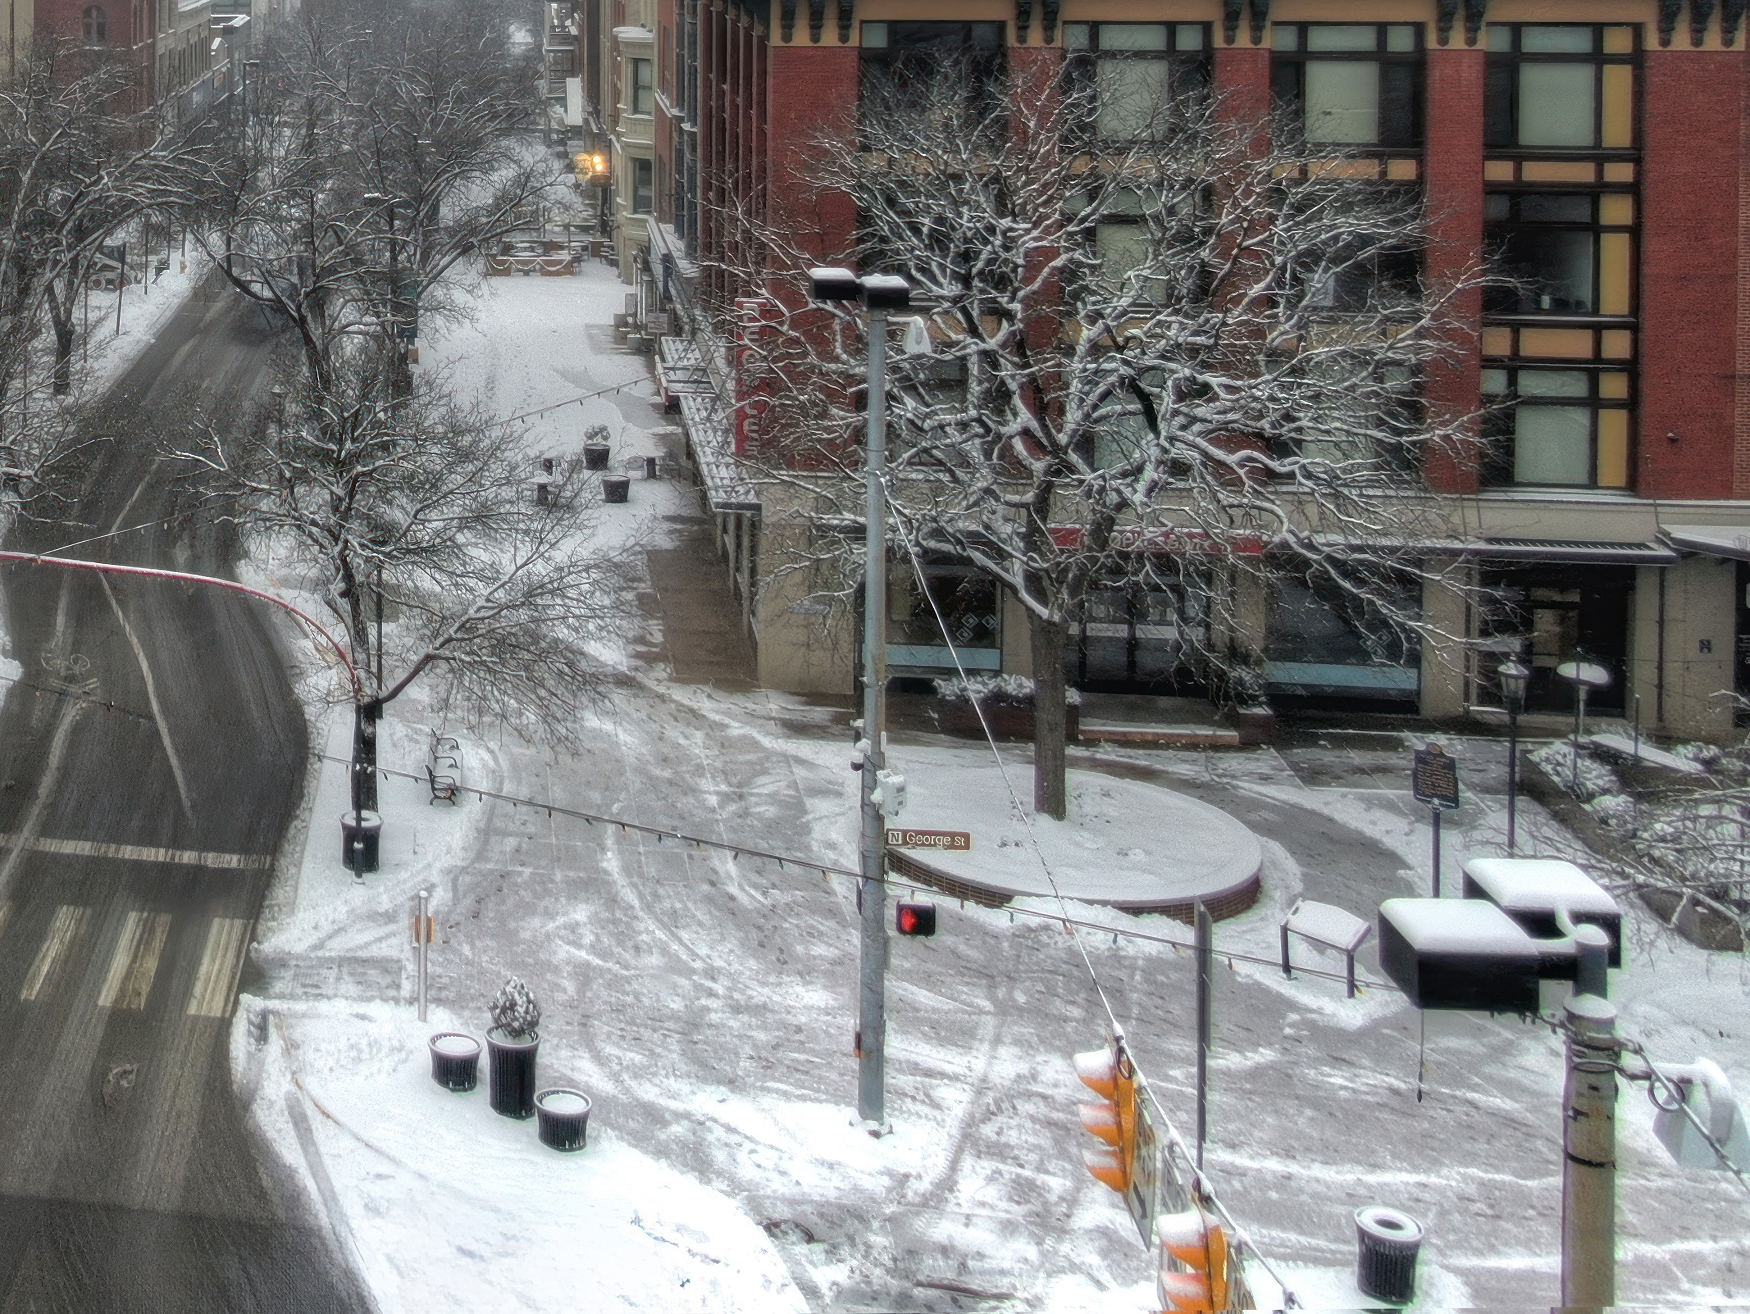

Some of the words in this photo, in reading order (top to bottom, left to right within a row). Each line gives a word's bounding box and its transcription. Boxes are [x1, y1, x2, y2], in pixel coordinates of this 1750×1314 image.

[890, 832, 901, 843] N
[906, 832, 951, 846] George
[954, 836, 965, 846] St
